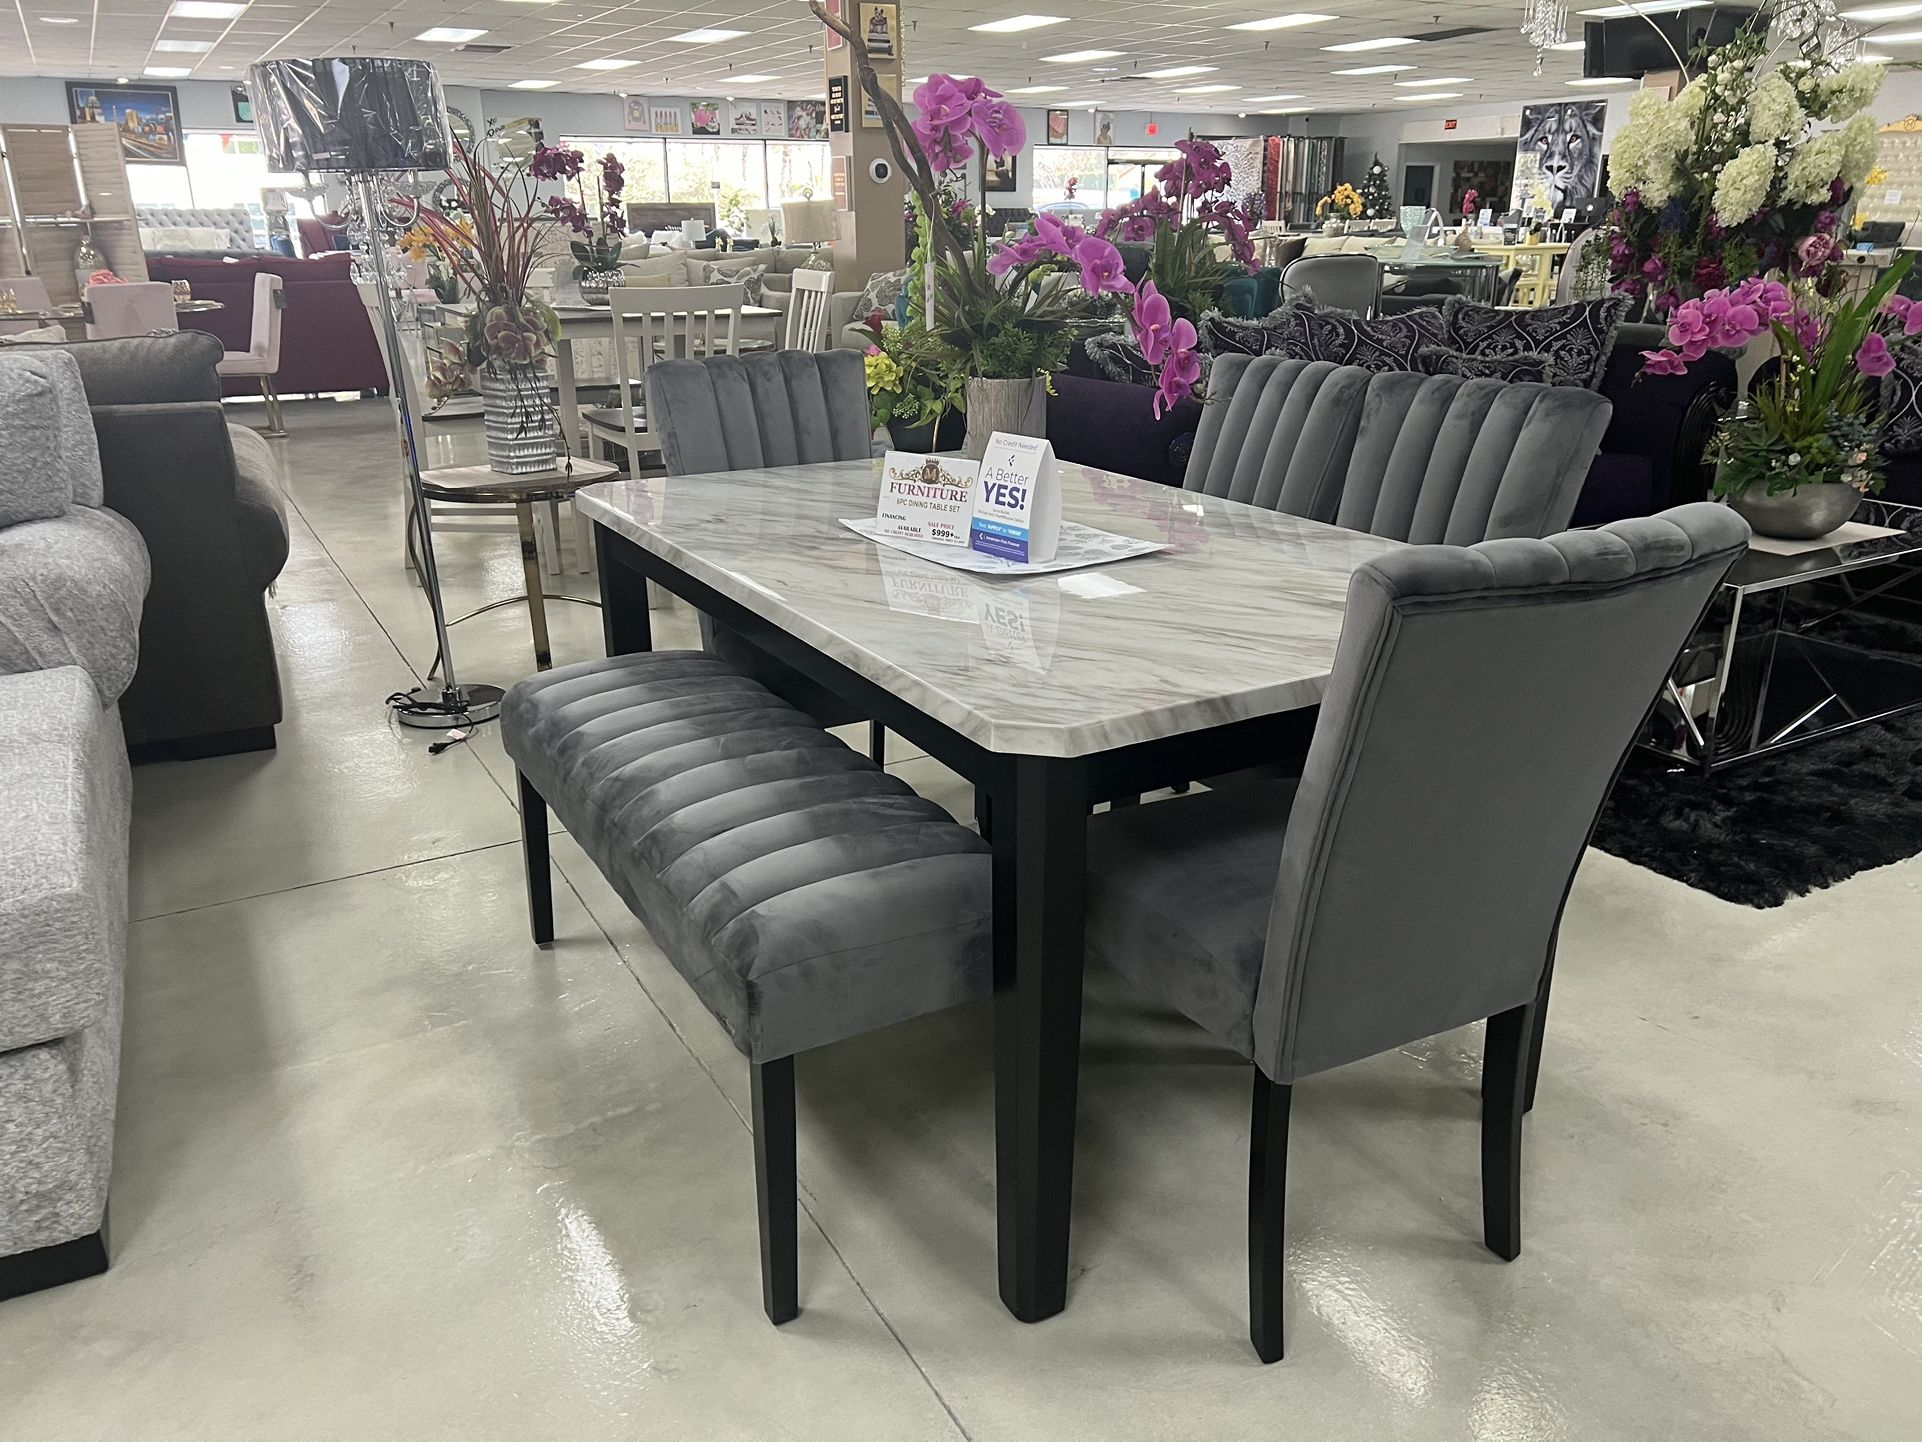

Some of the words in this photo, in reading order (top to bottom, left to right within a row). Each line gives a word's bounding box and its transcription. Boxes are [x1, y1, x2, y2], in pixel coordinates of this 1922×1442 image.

[1002, 439, 1018, 447] Credit
[985, 467, 993, 479] A
[995, 468, 1029, 486] Better
[890, 482, 968, 503] FURNITURE
[983, 480, 1027, 511] YES!
[908, 499, 928, 509] DINING
[929, 502, 947, 512] TABLE
[882, 512, 906, 521] FINANCING
[940, 522, 955, 530] PRICE
